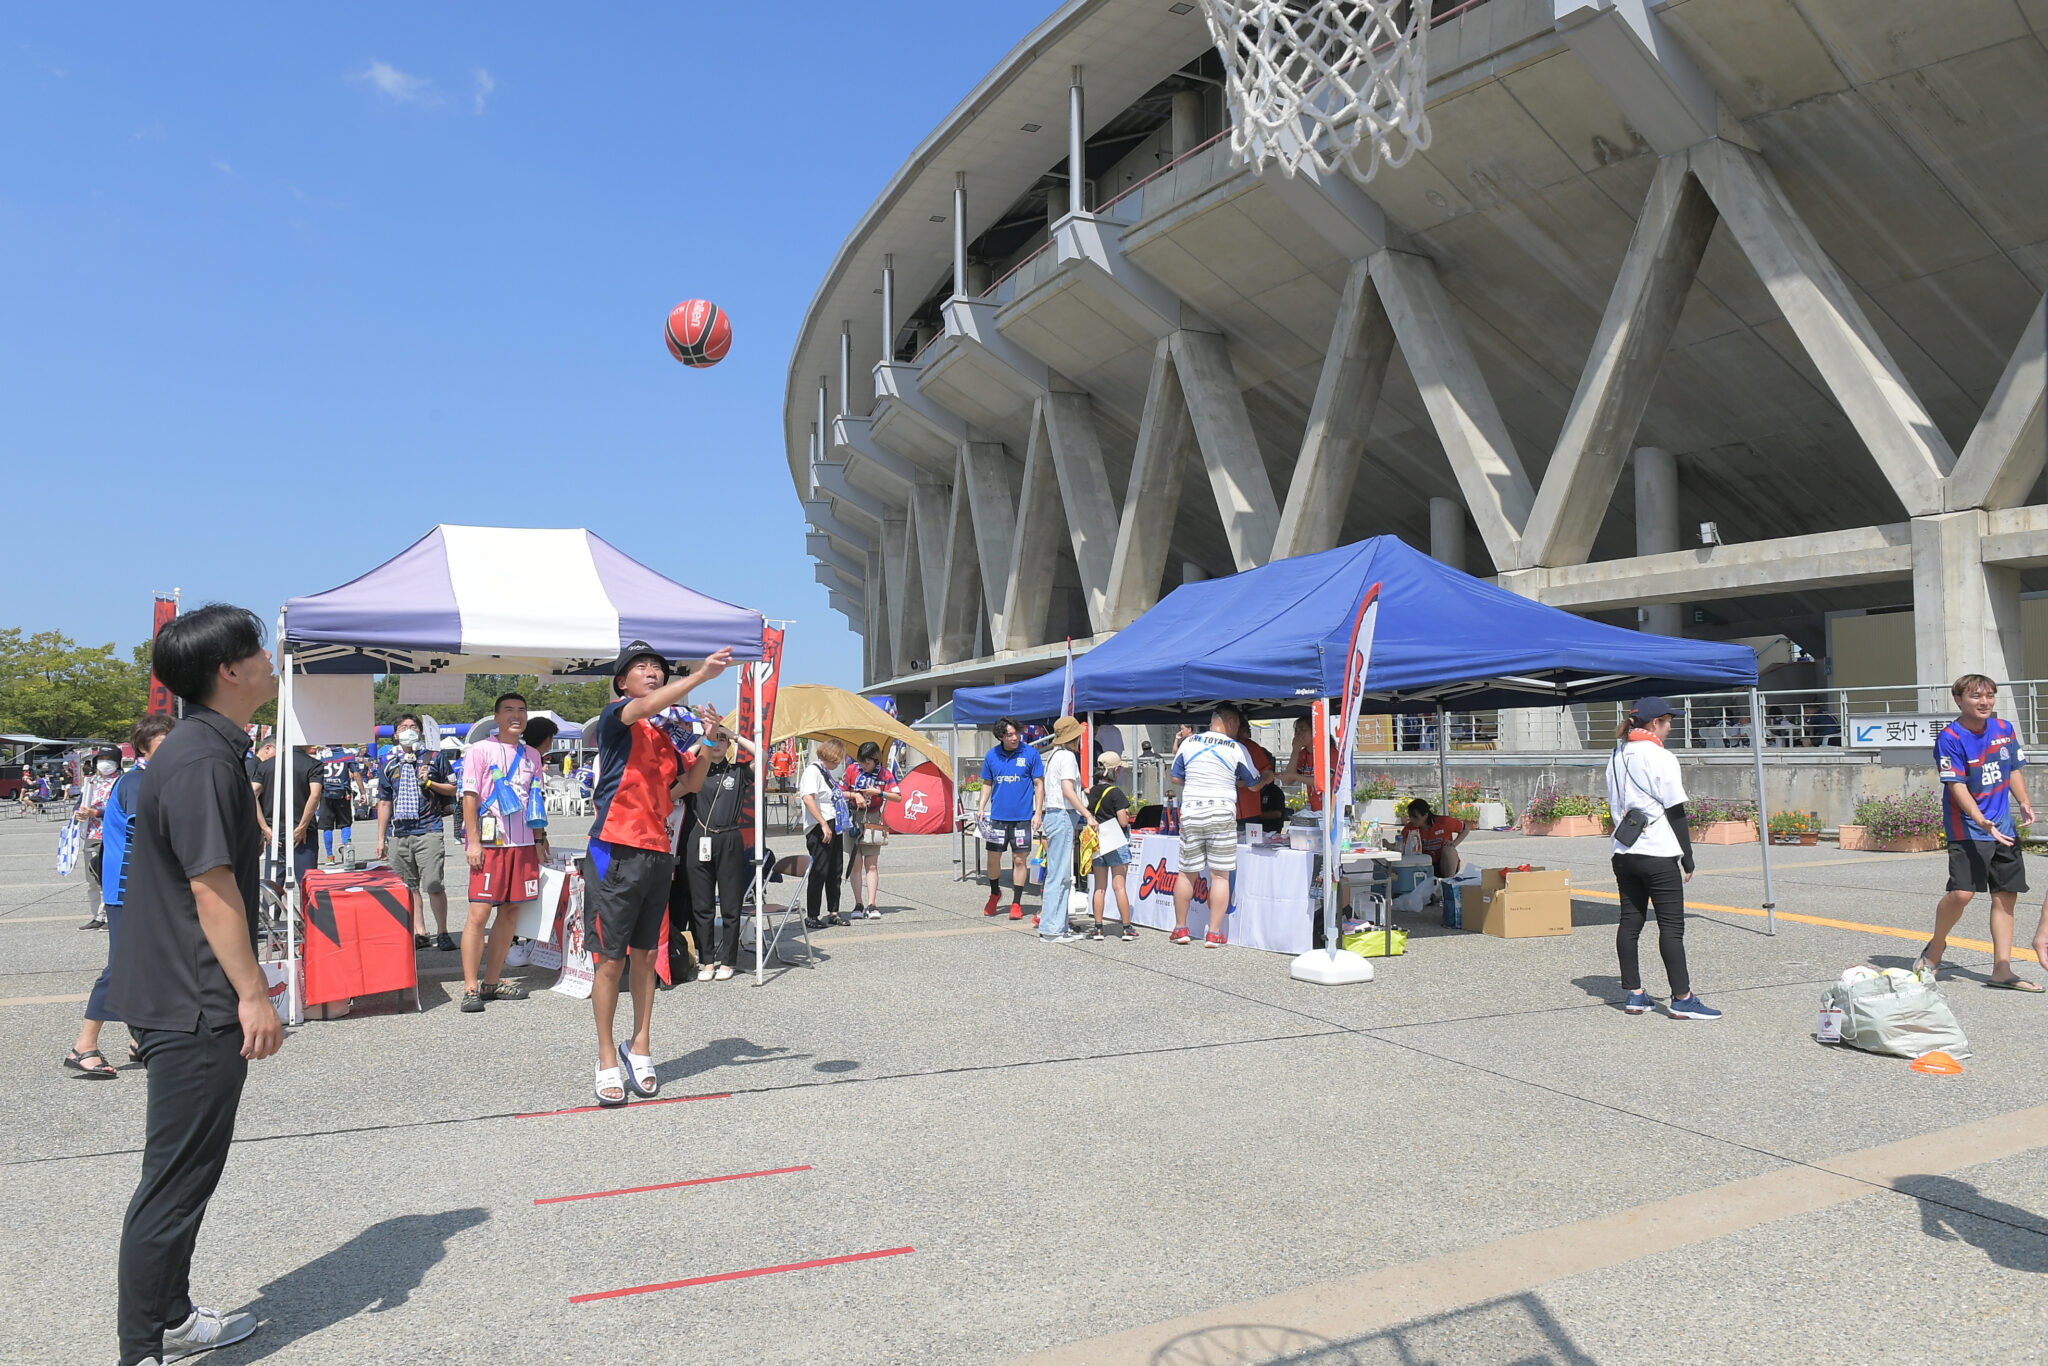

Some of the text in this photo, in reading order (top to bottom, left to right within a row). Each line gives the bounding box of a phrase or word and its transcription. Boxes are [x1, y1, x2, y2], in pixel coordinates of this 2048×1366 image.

[1695, 611, 1704, 622] E
[1204, 736, 1236, 749] TOYAMA
[996, 773, 1021, 784] graph
[484, 873, 491, 891] 1
